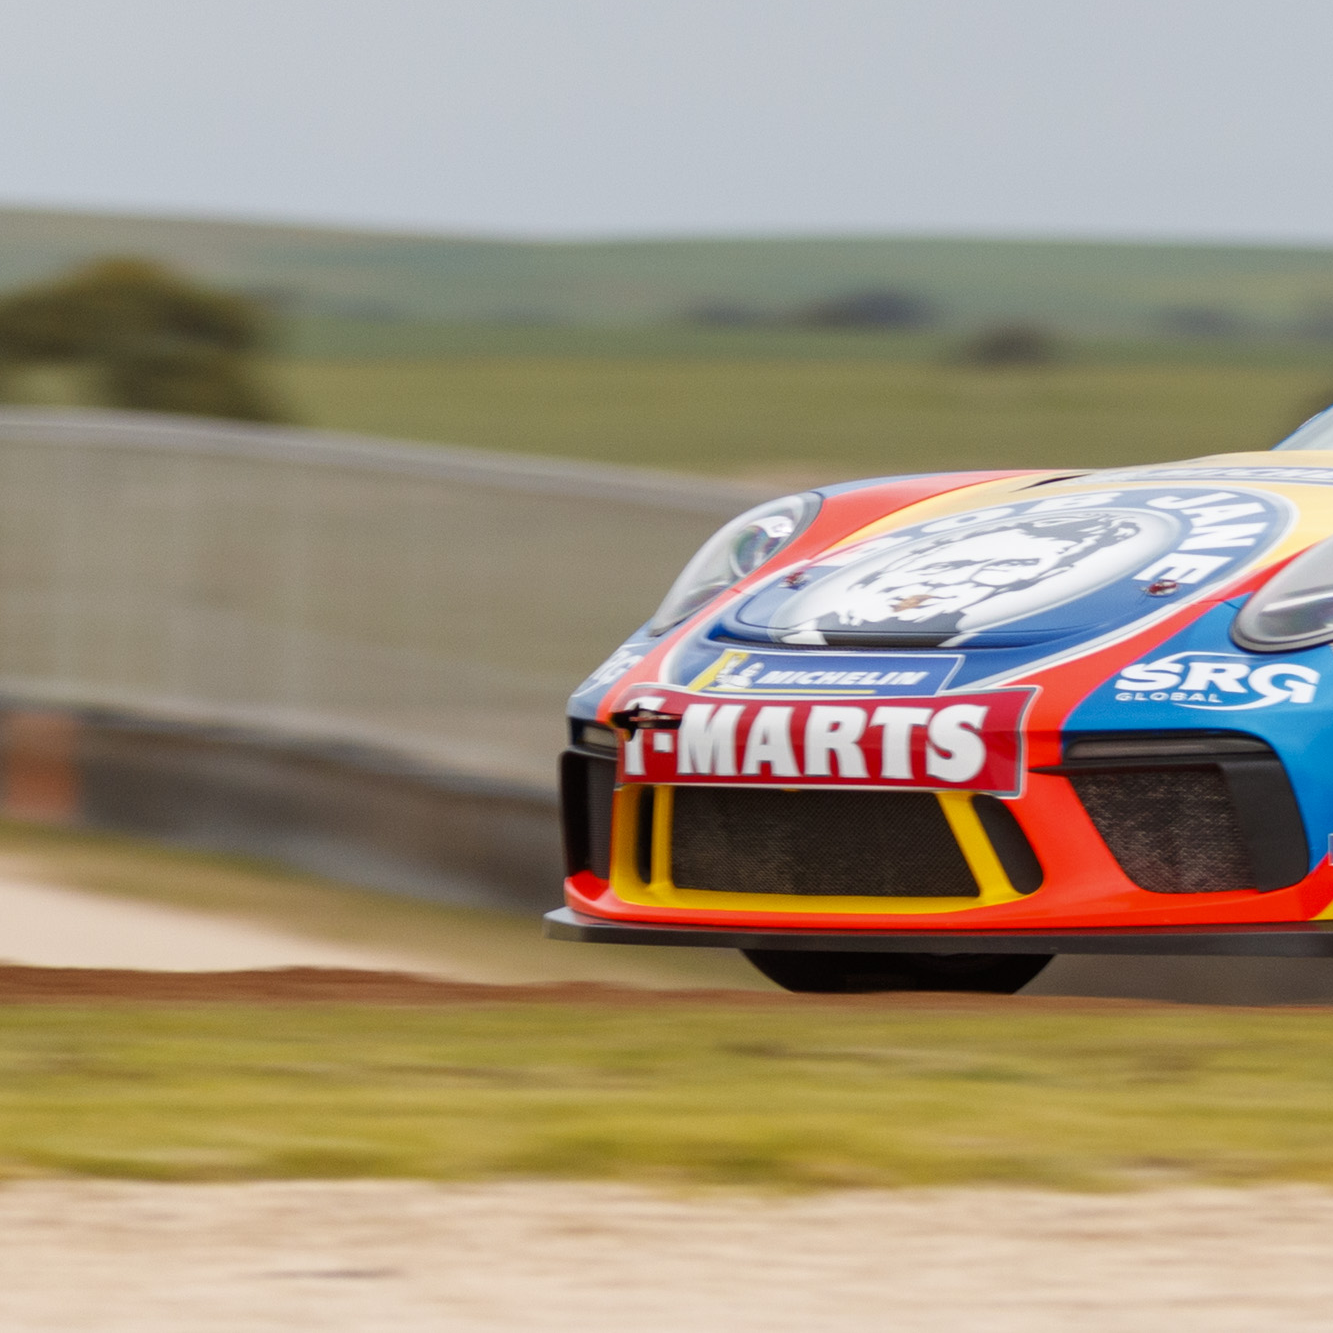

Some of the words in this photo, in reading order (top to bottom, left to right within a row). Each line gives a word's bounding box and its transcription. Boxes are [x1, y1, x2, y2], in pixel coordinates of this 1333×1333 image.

[812, 493, 1123, 566] BOB
[1132, 492, 1268, 584] JANE
[755, 670, 931, 685] MICHELIN
[1114, 651, 1321, 710] SRG
[1114, 691, 1224, 703] GLOBAL
